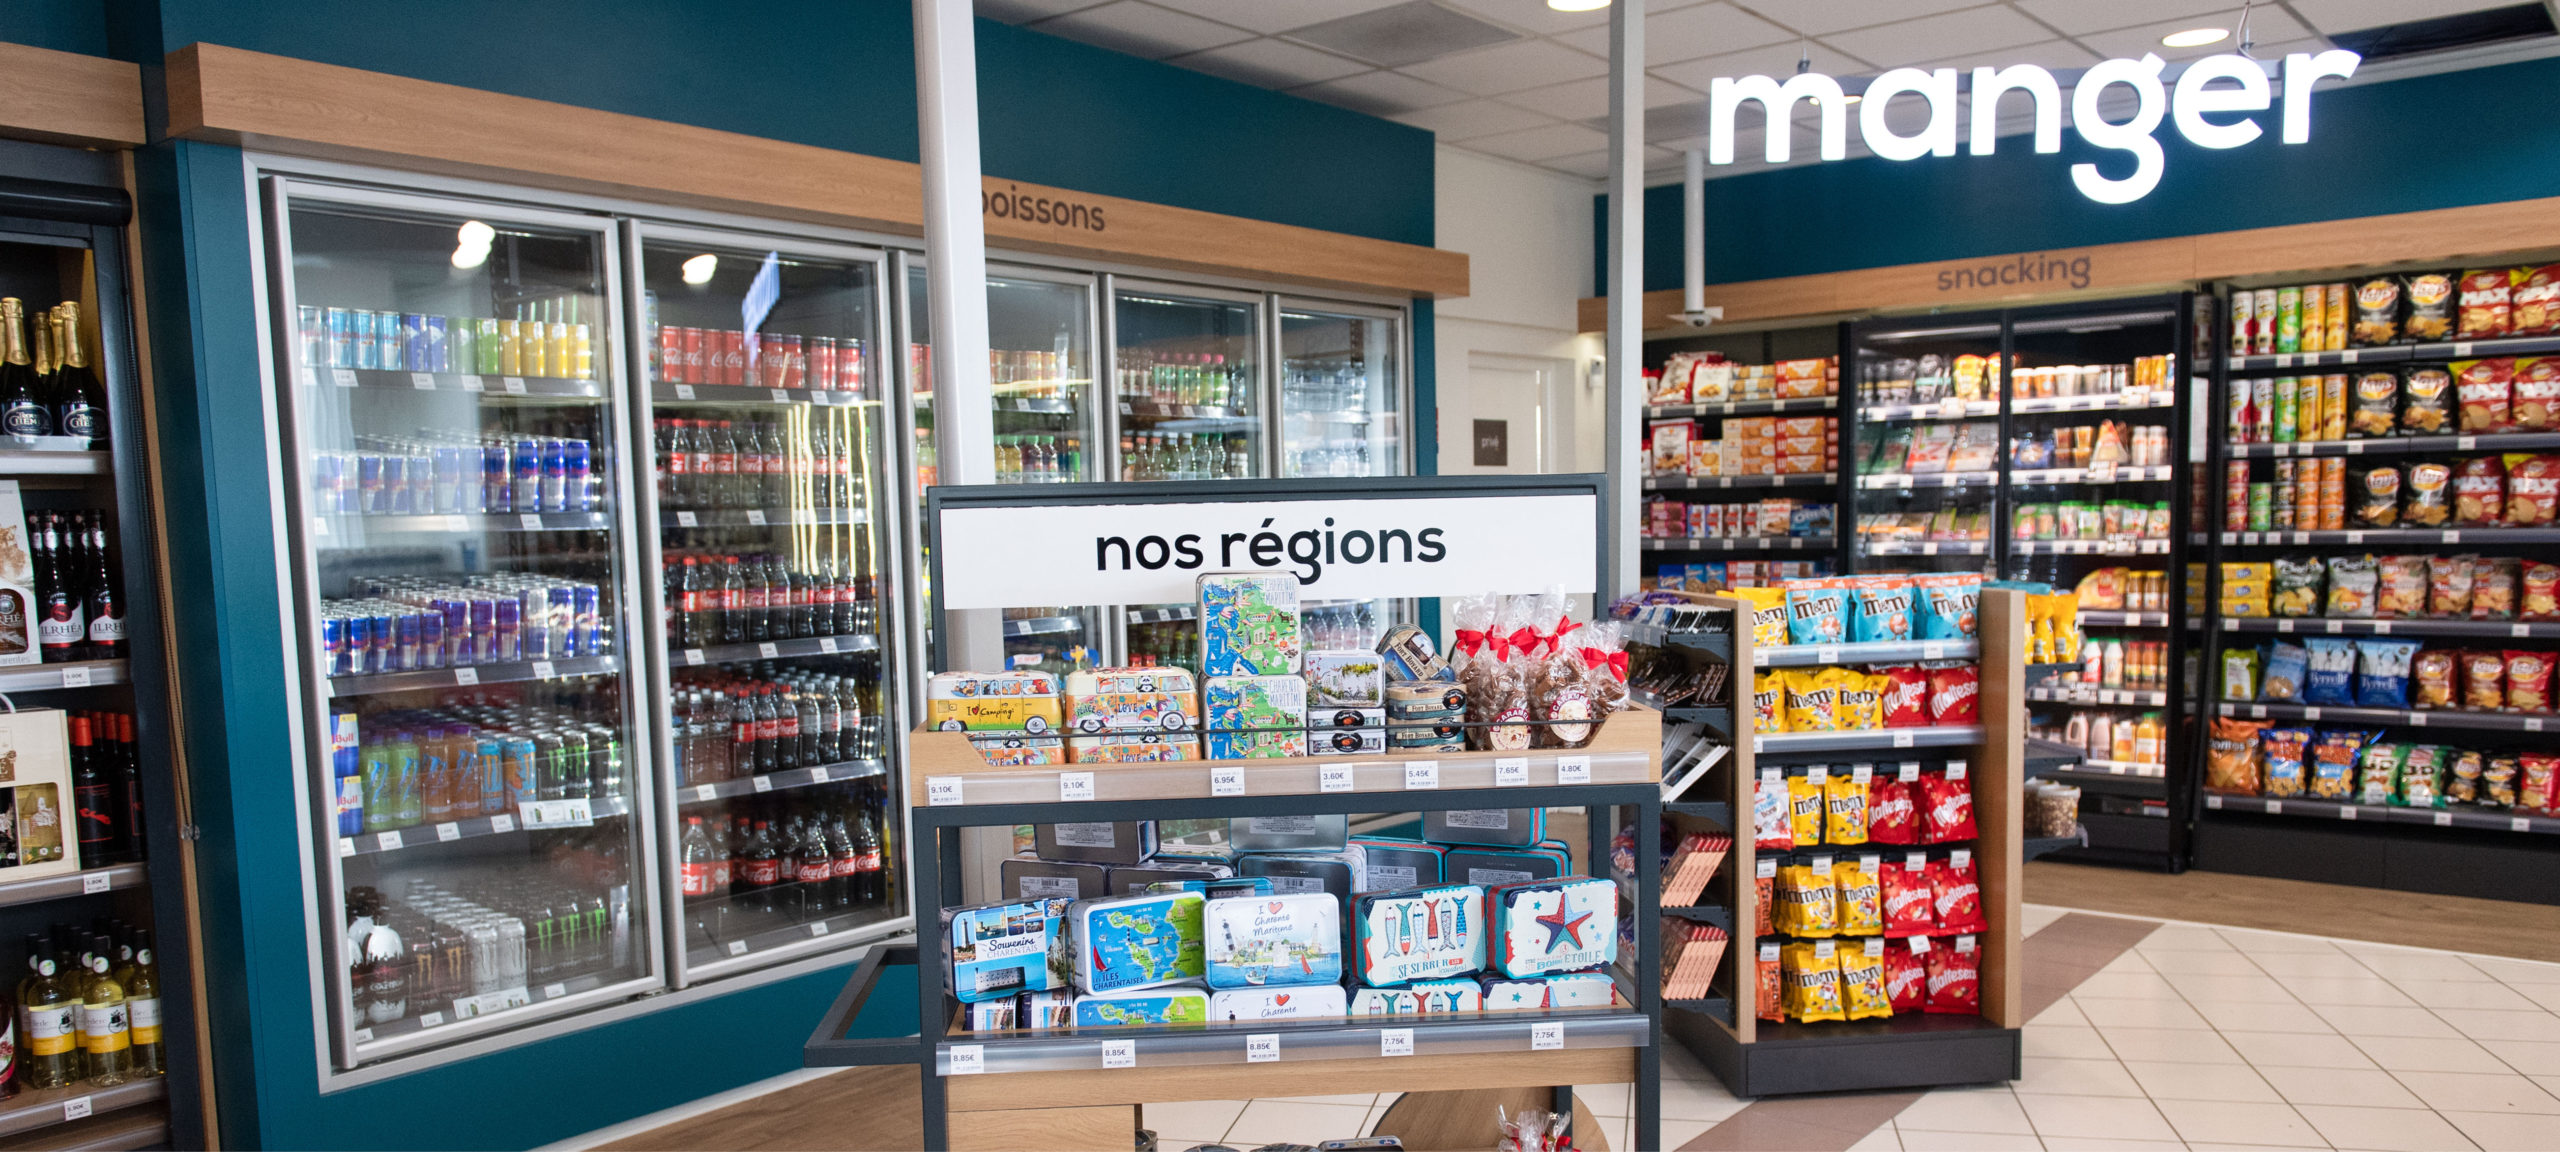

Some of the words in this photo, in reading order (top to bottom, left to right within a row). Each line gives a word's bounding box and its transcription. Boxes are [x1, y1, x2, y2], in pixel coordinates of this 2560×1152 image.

[1709, 49, 2362, 204] manger
[1937, 254, 2091, 289] snacking
[1096, 533, 1204, 570] nos
[1221, 517, 1446, 585] régions
[1560, 764, 1583, 773] 4.80€
[1323, 772, 1345, 781] 3.60€
[1408, 769, 1430, 778] 5.45€
[1213, 776, 1237, 785] 6.95€
[930, 786, 953, 794] 9.10€
[1063, 781, 1085, 790] 9.10€
[1254, 913, 1290, 927] Charente
[988, 936, 1035, 952] Souvenirs
[986, 945, 1038, 959] CHARENTAIS
[1093, 976, 1144, 991] CHARENTAISES
[1265, 997, 1270, 1006] I
[1261, 1006, 1296, 1018] Charente
[1535, 1031, 1556, 1039] 7.75€
[1384, 1037, 1405, 1046] 7.75€
[1249, 1042, 1270, 1051] 8.85€
[1104, 1048, 1126, 1057] 8.85€
[953, 1054, 975, 1063] 8.85€
